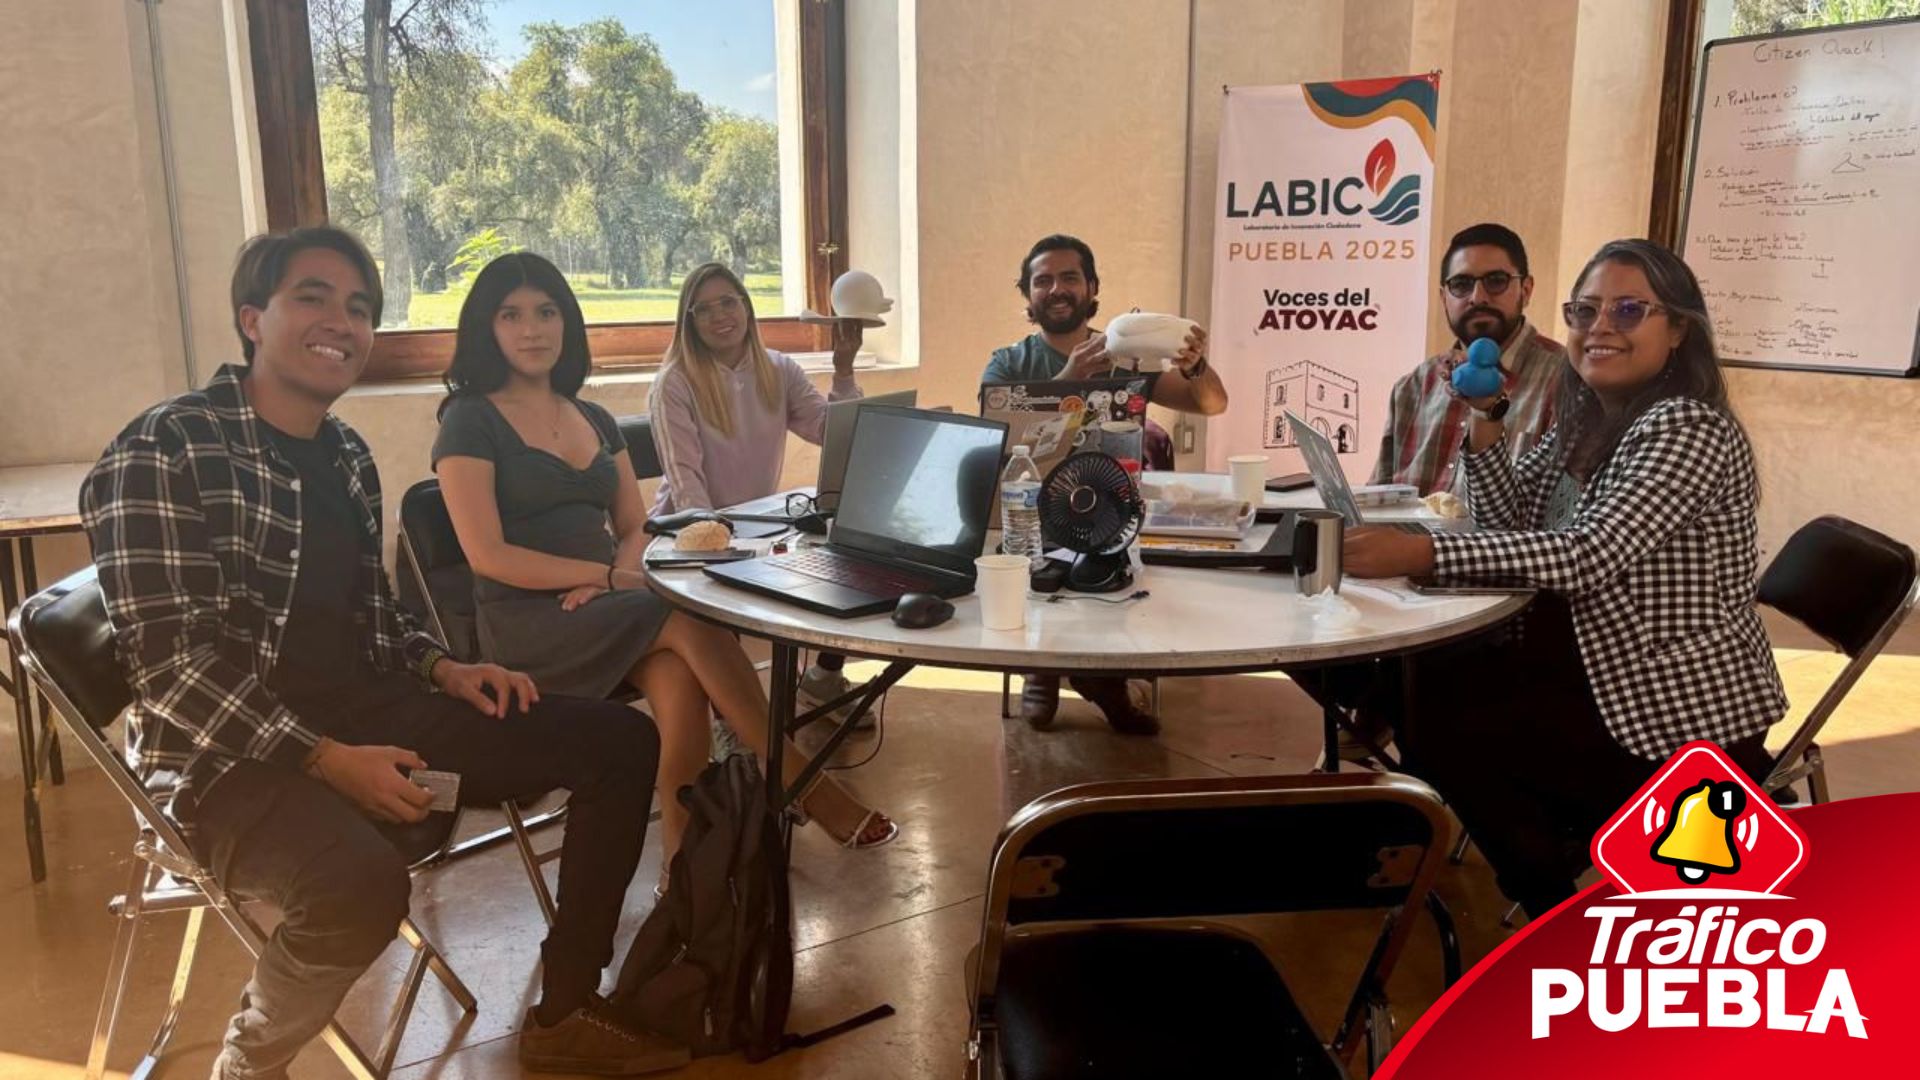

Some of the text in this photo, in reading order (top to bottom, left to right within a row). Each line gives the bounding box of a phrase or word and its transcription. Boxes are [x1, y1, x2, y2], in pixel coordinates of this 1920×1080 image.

[1753, 42, 1811, 63] Citizen
[1727, 90, 1778, 106] Problema
[1226, 176, 1365, 218] LABIC
[1228, 239, 1415, 262] PUEBLA 2025
[1263, 288, 1370, 307] Voces del
[1258, 309, 1379, 331] ATOYAC
